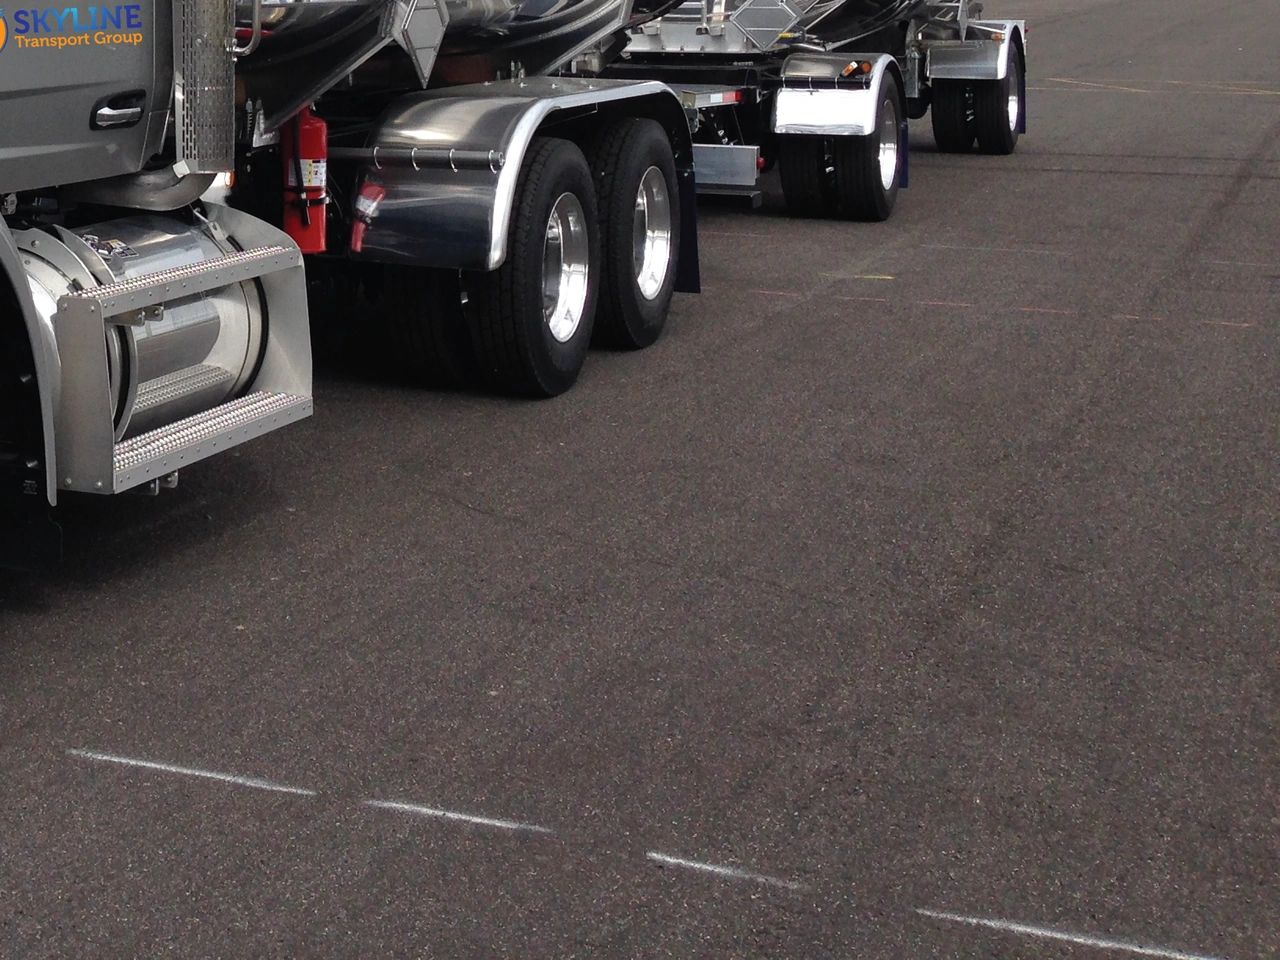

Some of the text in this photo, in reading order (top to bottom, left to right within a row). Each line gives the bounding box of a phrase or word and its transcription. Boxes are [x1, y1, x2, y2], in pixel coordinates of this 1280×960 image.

[13, 4, 143, 35] SKYLINE
[14, 31, 143, 49] Transport Group
